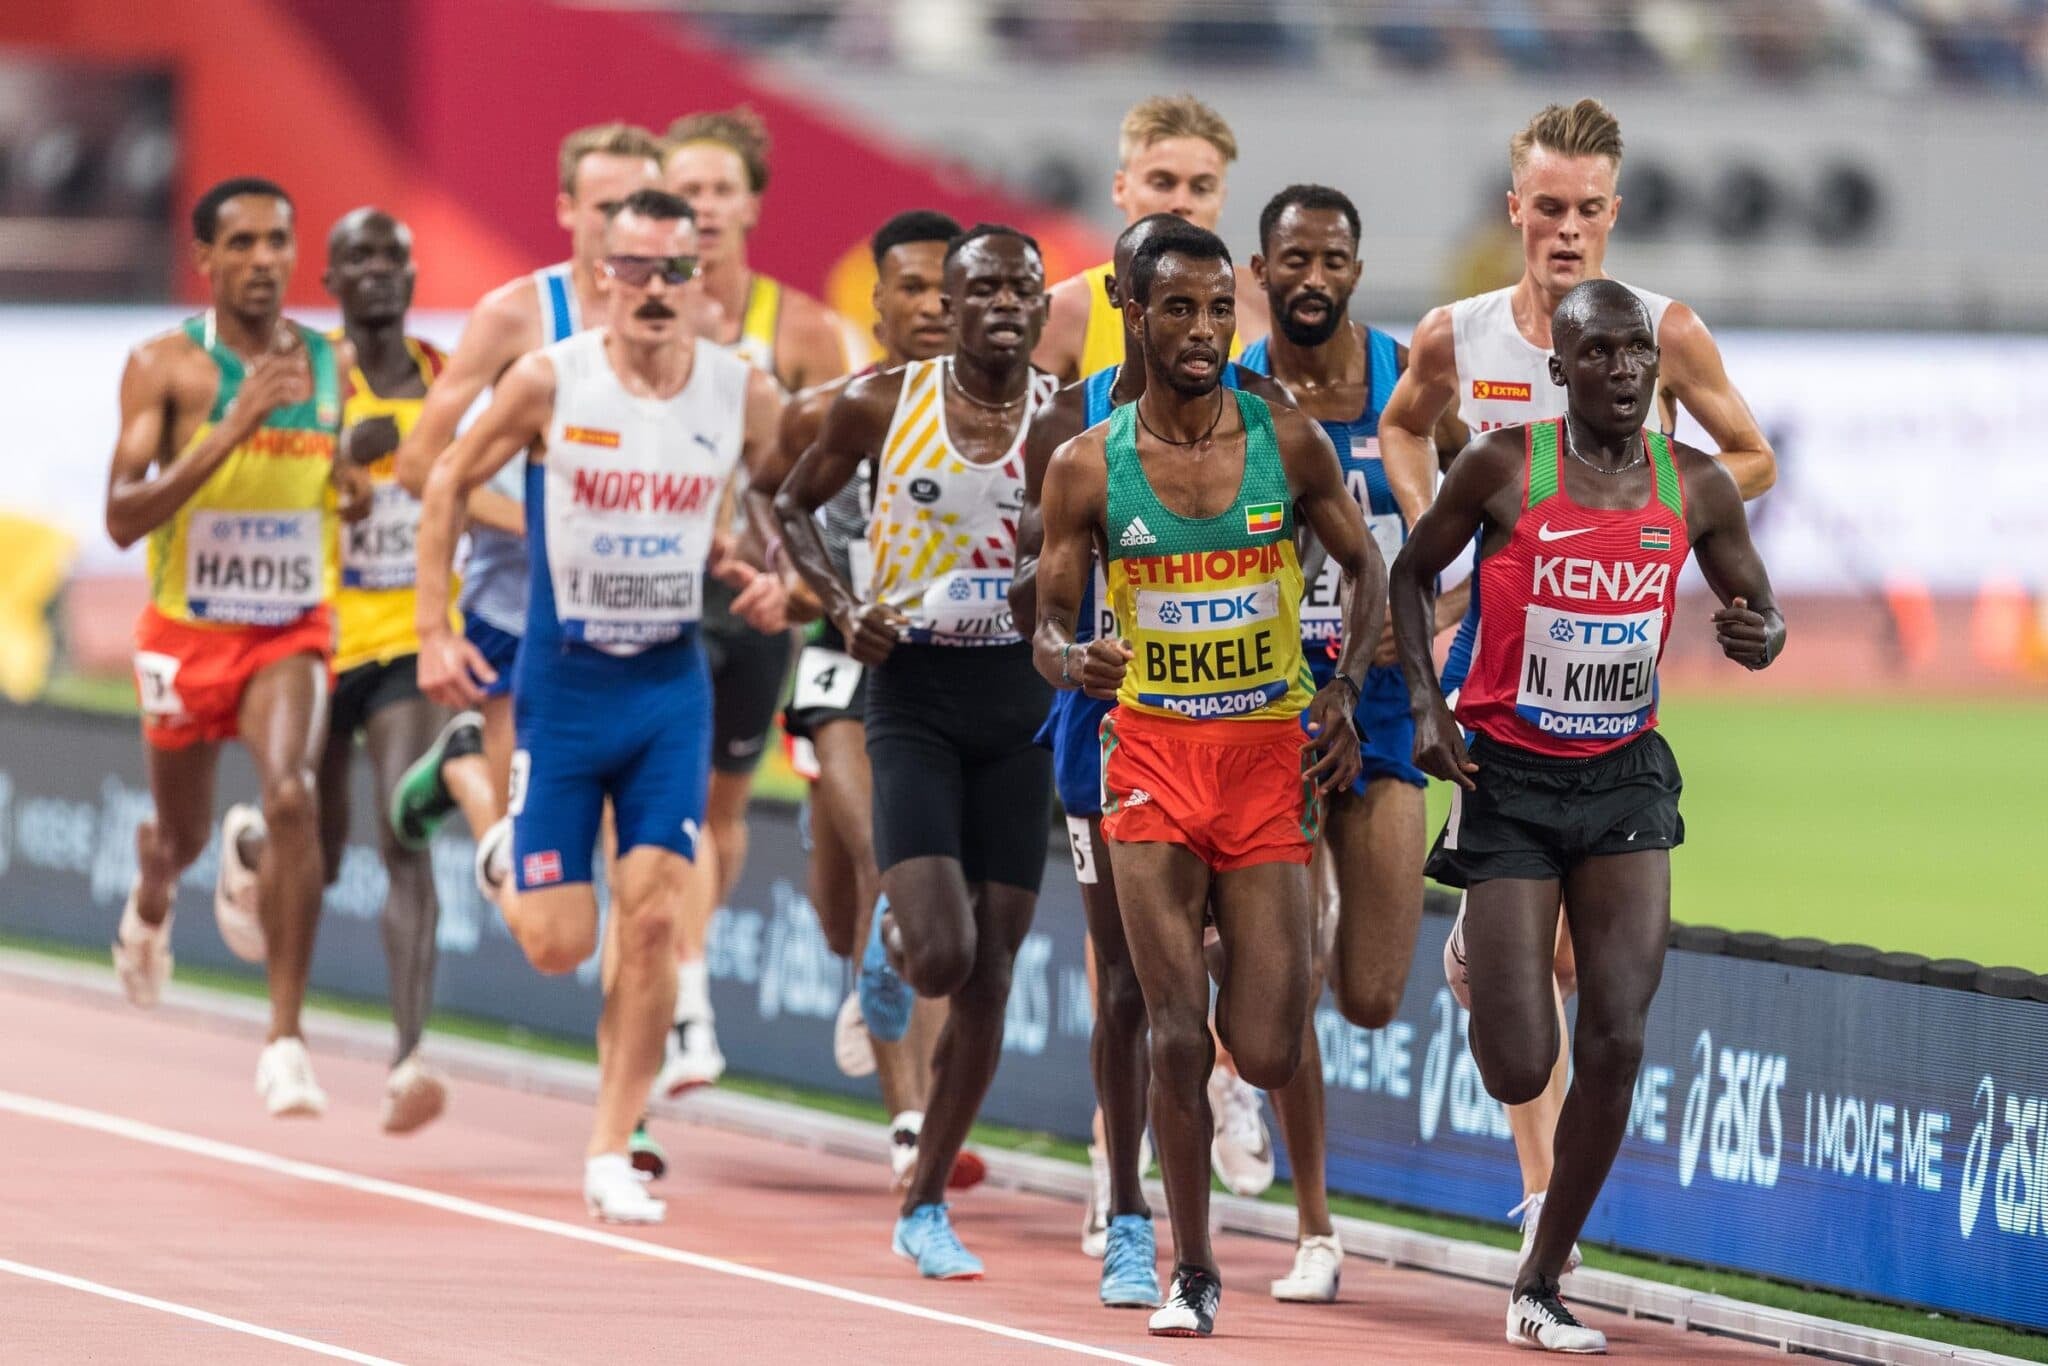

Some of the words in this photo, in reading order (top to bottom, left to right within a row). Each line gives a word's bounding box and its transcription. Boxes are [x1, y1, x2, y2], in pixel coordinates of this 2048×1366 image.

[1492, 386, 1529, 397] EXTRA
[238, 518, 299, 541] TDK
[1119, 533, 1157, 547] adidas
[619, 534, 683, 557] TDK
[195, 553, 313, 593] HADIS
[1122, 544, 1285, 586] ETHIOPIA
[1532, 555, 1671, 603] KENYA
[970, 578, 1013, 601] TD
[1180, 591, 1259, 625] TDK
[1574, 618, 1650, 646] TDK
[1146, 630, 1274, 684] BEKELE
[813, 665, 837, 693] 4
[1526, 654, 1553, 698] N.
[1563, 656, 1653, 702] KIMELI
[1163, 689, 1267, 717] DOHA2019
[1539, 711, 1637, 735] DOHA2019
[1803, 1091, 1813, 1168] I
[1816, 1093, 1897, 1184] MOVE
[1901, 1108, 1945, 1192] ME
